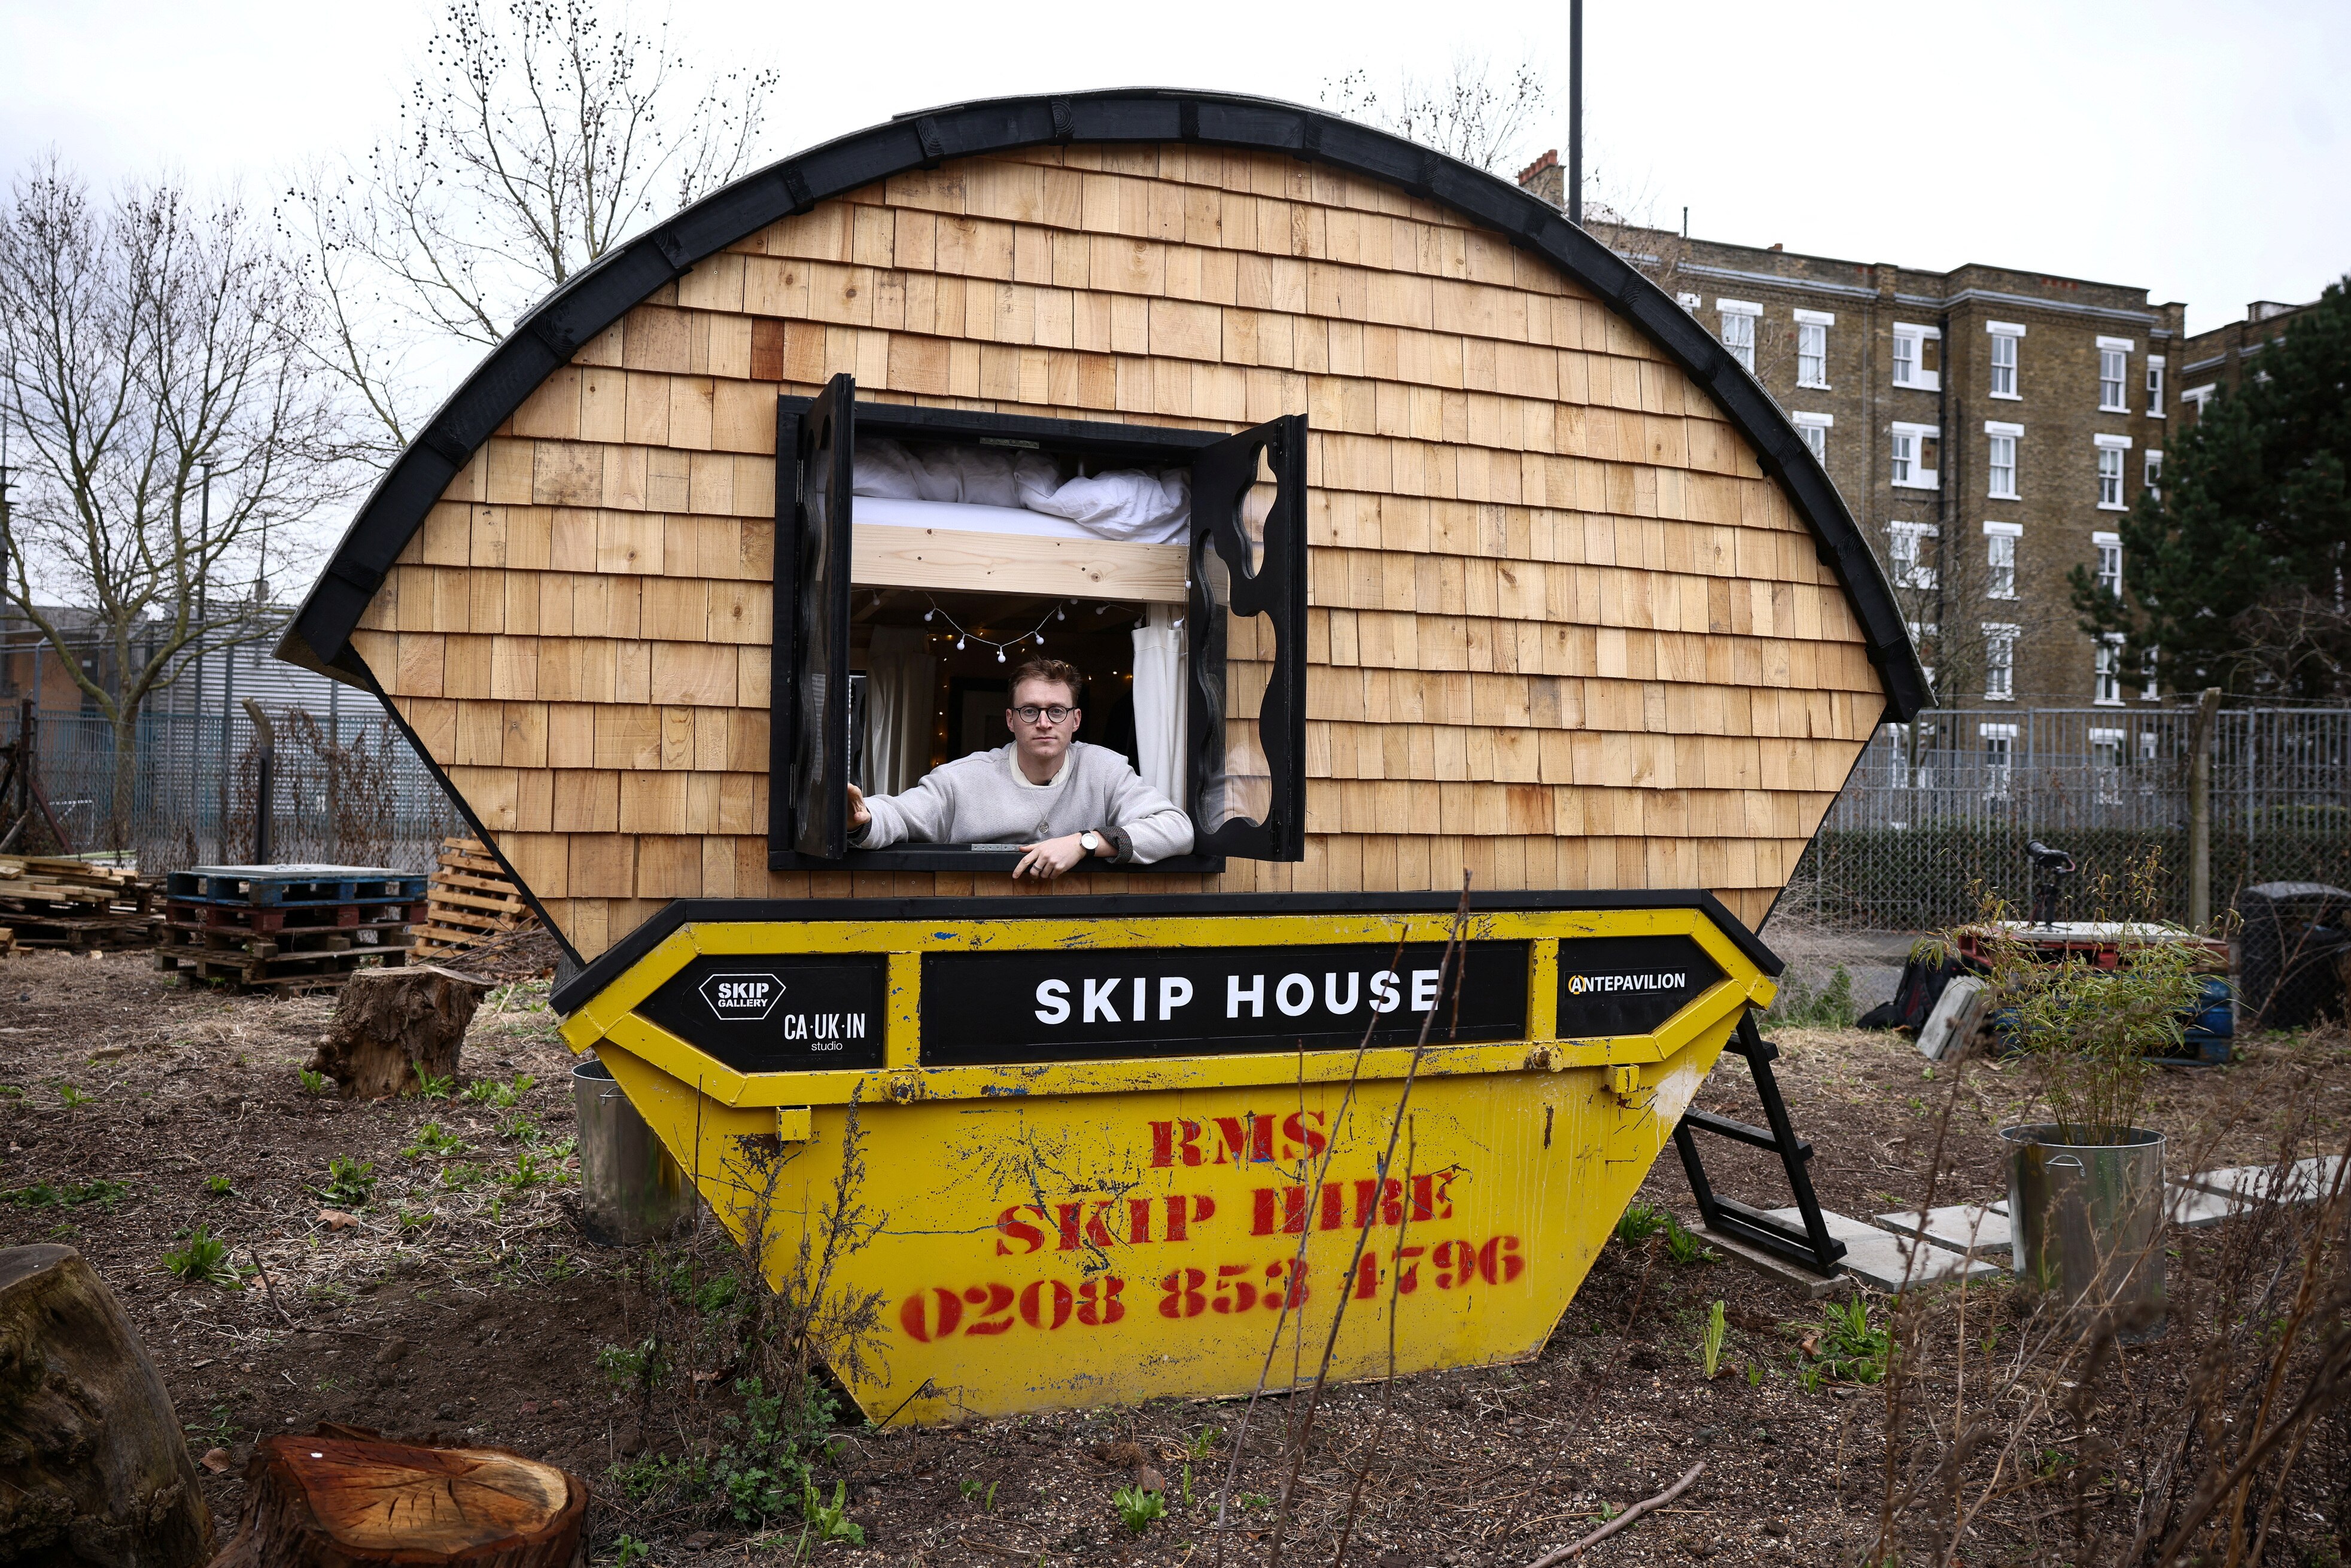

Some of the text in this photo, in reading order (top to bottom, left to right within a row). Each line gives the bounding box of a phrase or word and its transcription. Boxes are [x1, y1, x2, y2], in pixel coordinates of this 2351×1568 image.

[718, 982, 770, 998] SKIP
[1036, 970, 1439, 1025] SKIP HOUSE
[1568, 973, 1686, 994] ANTEPAVILION
[718, 999, 768, 1008] GALLERY
[811, 1041, 843, 1051] studio
[1148, 1111, 1327, 1168] RMS
[996, 1173, 1453, 1256] SKIP HIRE
[901, 1235, 1526, 1342] 0208 853 4796
